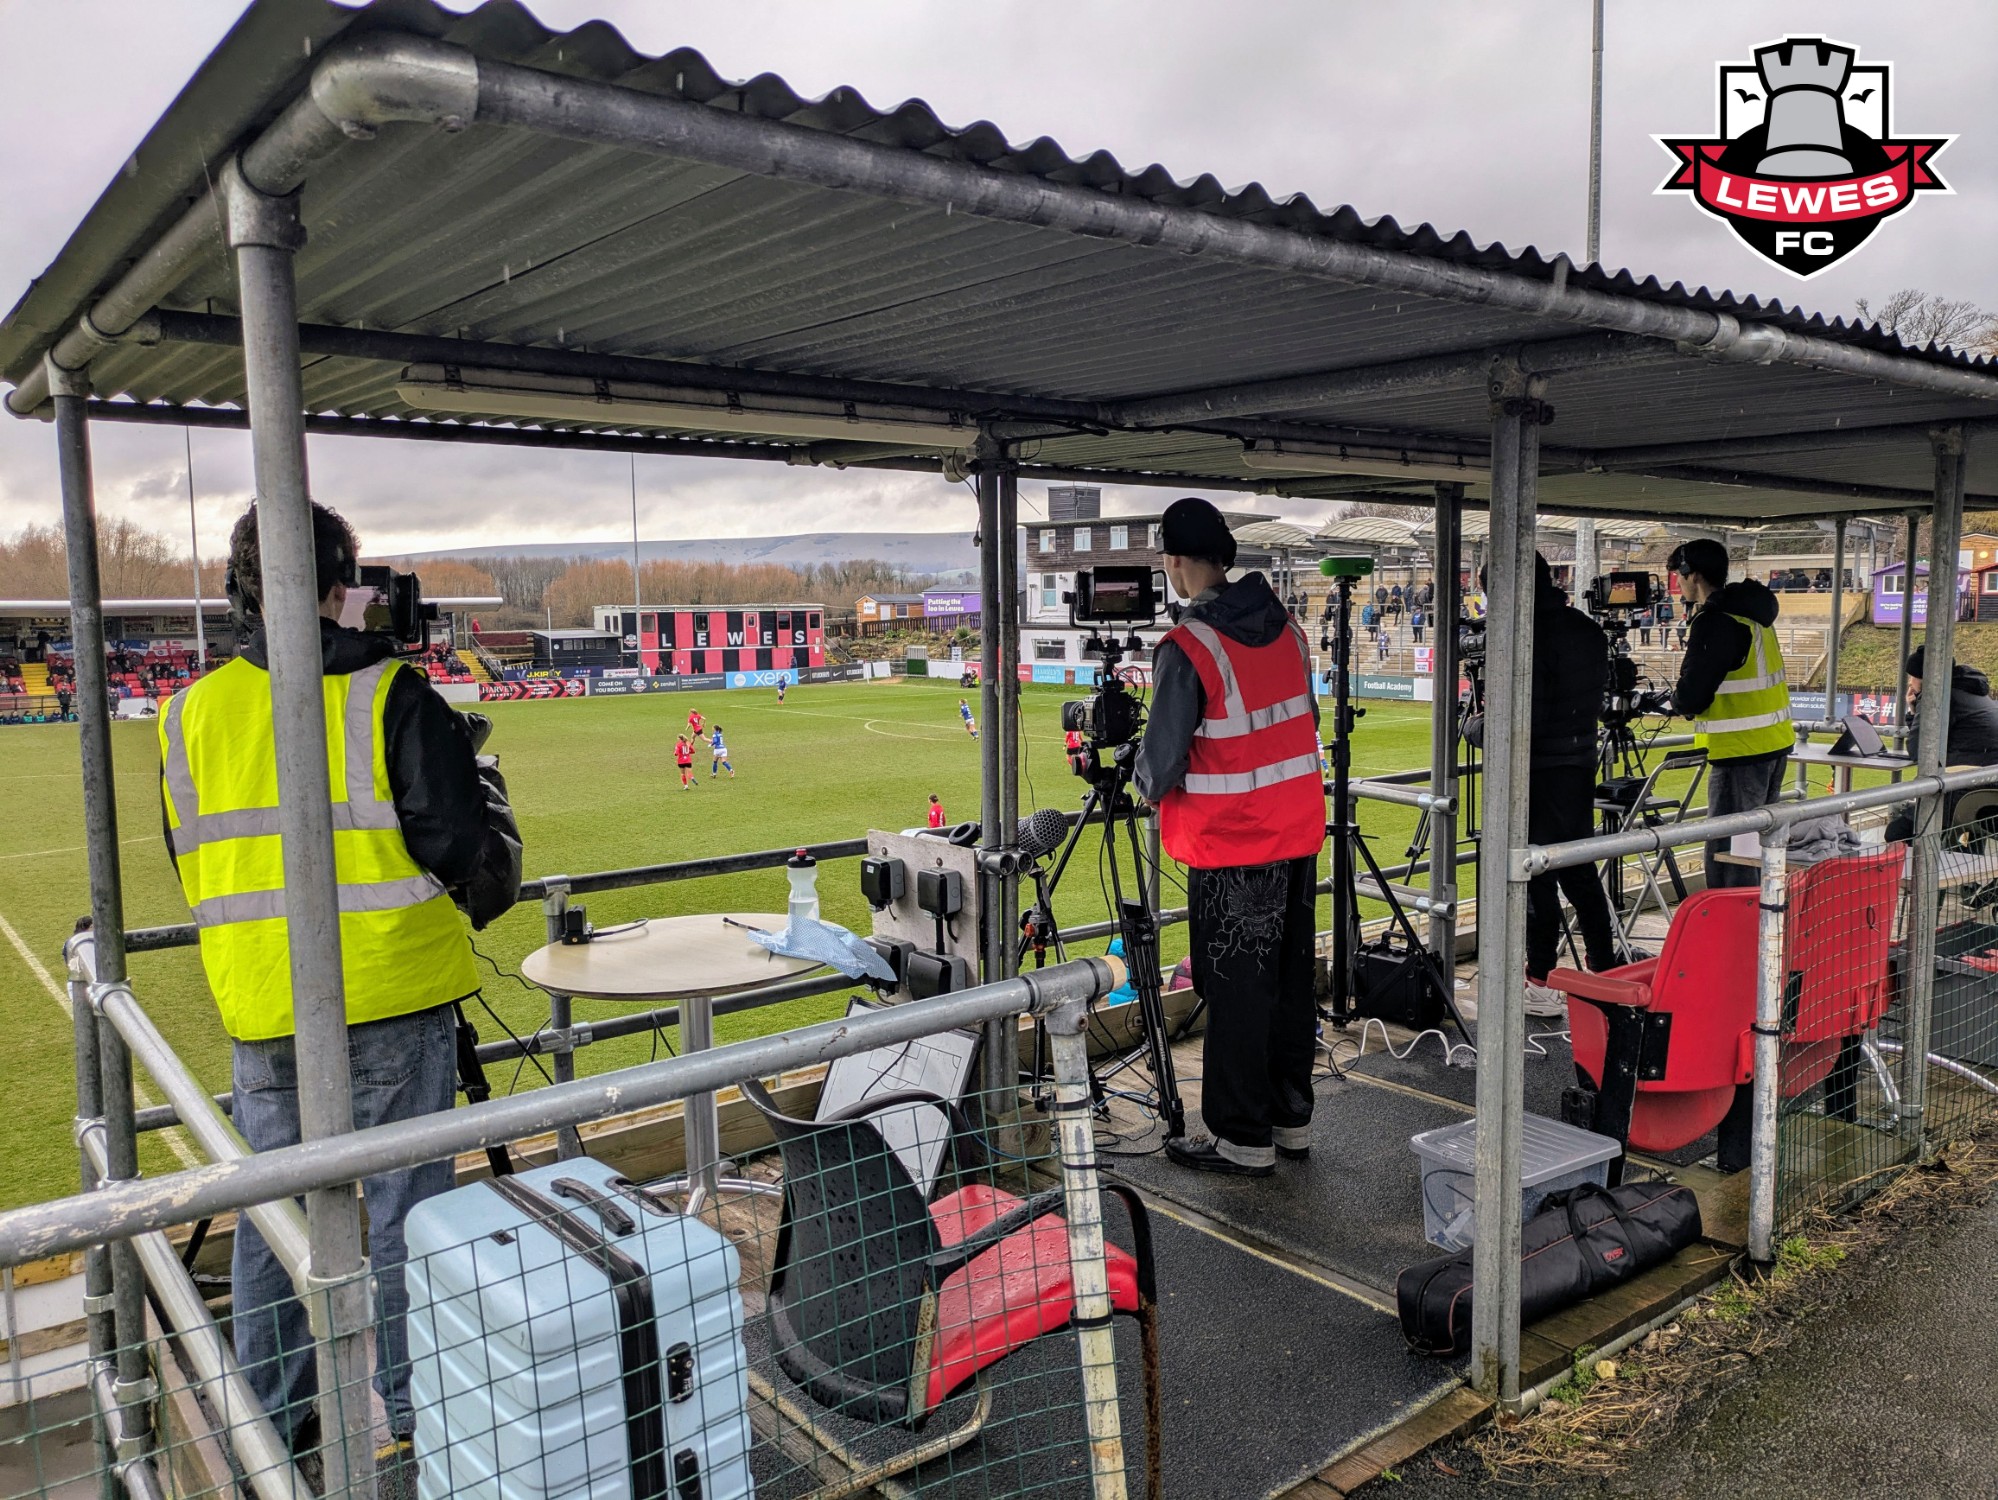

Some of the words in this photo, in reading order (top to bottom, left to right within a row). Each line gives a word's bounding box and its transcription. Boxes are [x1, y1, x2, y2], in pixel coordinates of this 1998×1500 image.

[662, 630, 805, 647] LEWES
[526, 670, 561, 678] J.KIRY
[753, 671, 792, 685] xero
[482, 685, 519, 694] HARVEY'S
[1364, 680, 1386, 690] Football
[1386, 681, 1412, 692] Academy
[682, 745, 690, 755] 10
